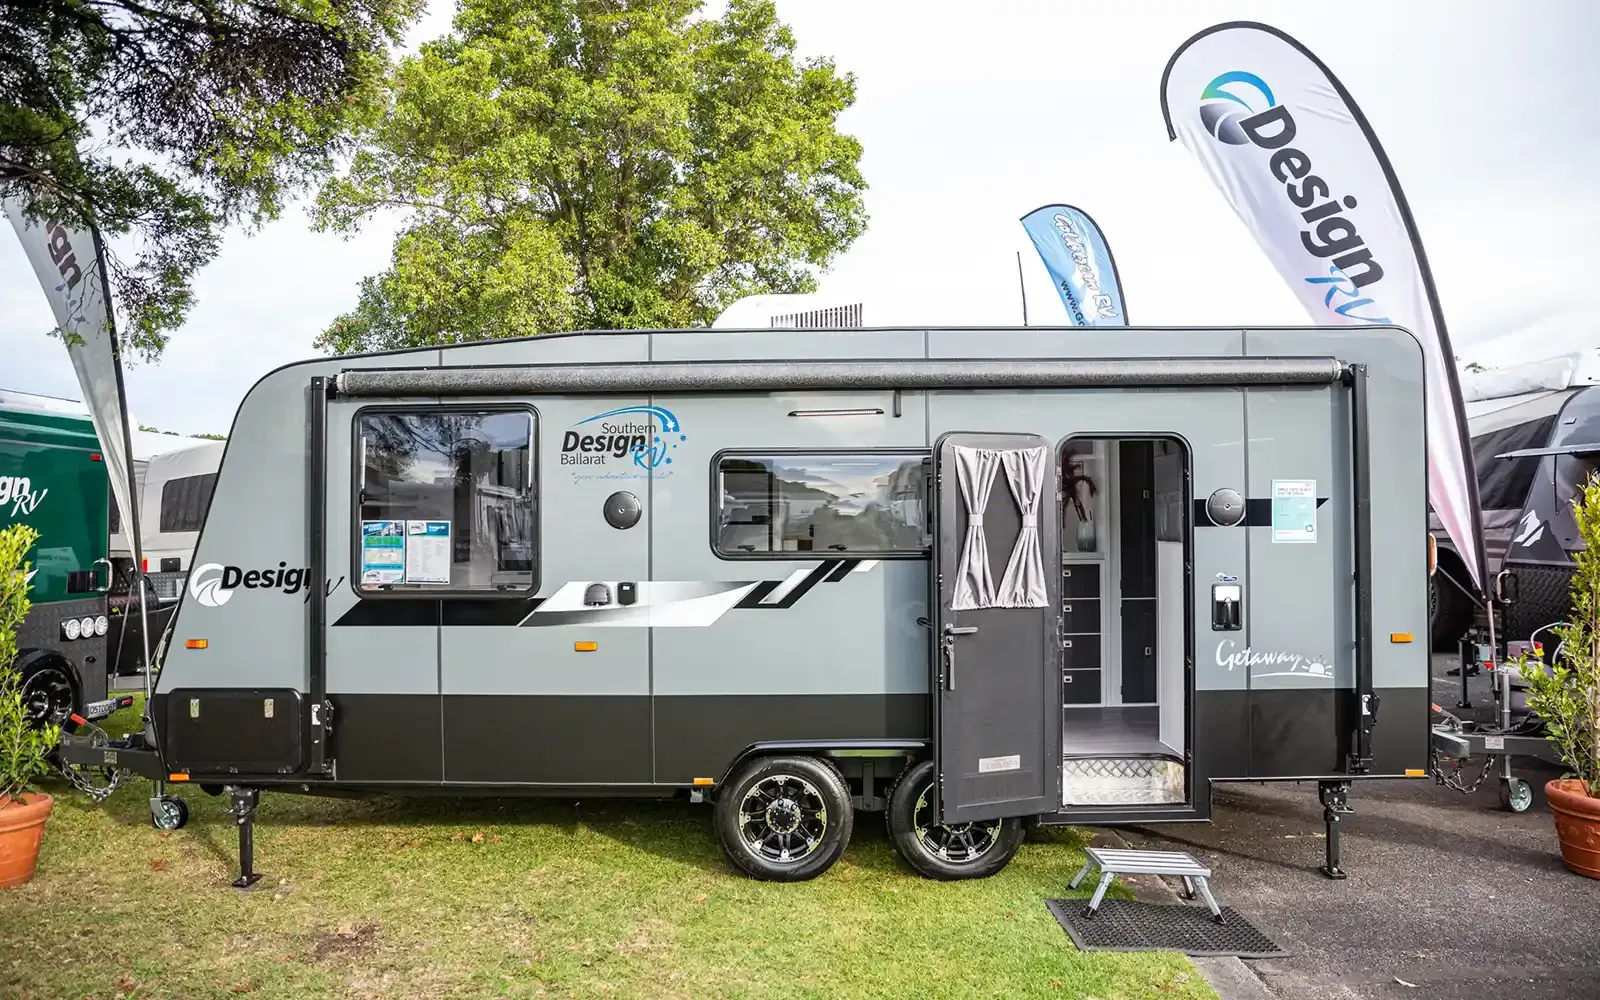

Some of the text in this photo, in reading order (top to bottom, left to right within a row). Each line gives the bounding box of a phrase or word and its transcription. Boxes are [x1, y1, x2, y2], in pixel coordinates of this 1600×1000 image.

[1239, 104, 1392, 324] Design RV
[601, 422, 656, 434] Southern
[560, 453, 606, 465] Ballarat
[562, 431, 667, 471] Design RV
[10, 488, 48, 518] RV
[1215, 639, 1304, 672] Getaway
